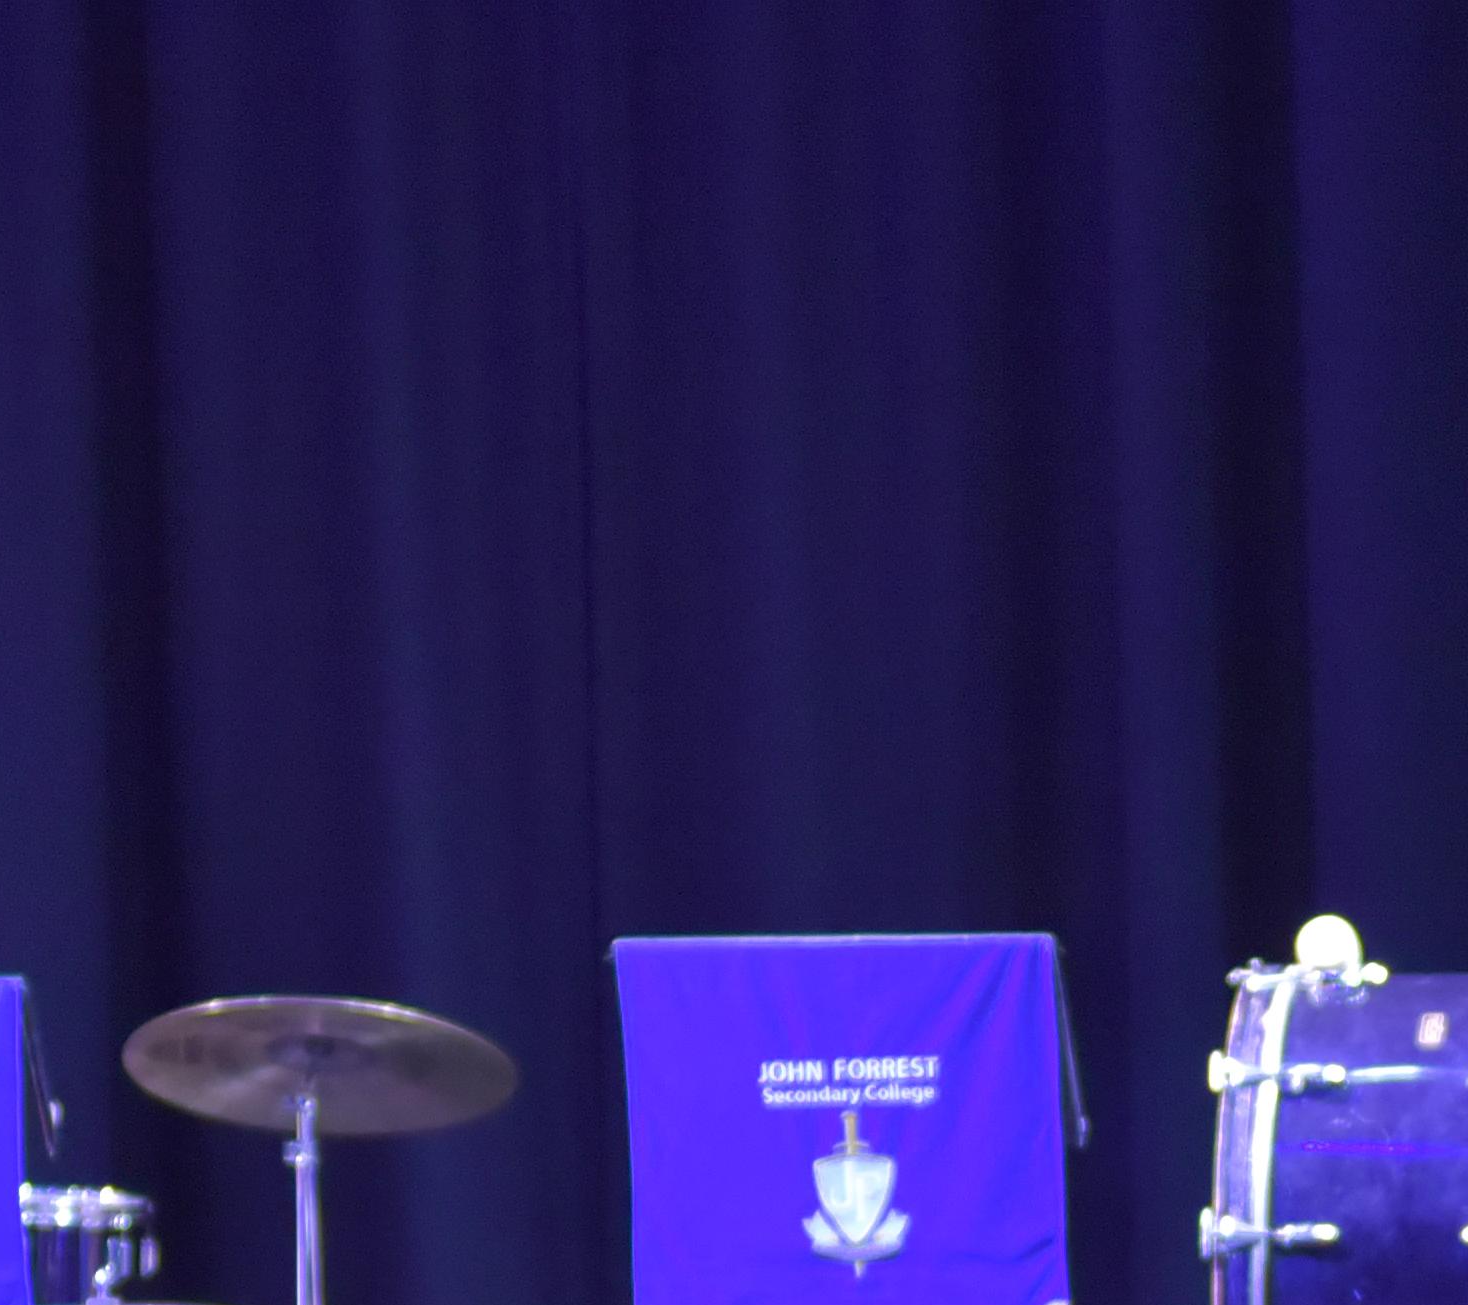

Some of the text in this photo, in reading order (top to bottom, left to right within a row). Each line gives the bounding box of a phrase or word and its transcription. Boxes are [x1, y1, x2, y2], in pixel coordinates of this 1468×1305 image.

[758, 1056, 938, 1083] JOHN FORREST
[761, 1083, 935, 1106] Secondary College
